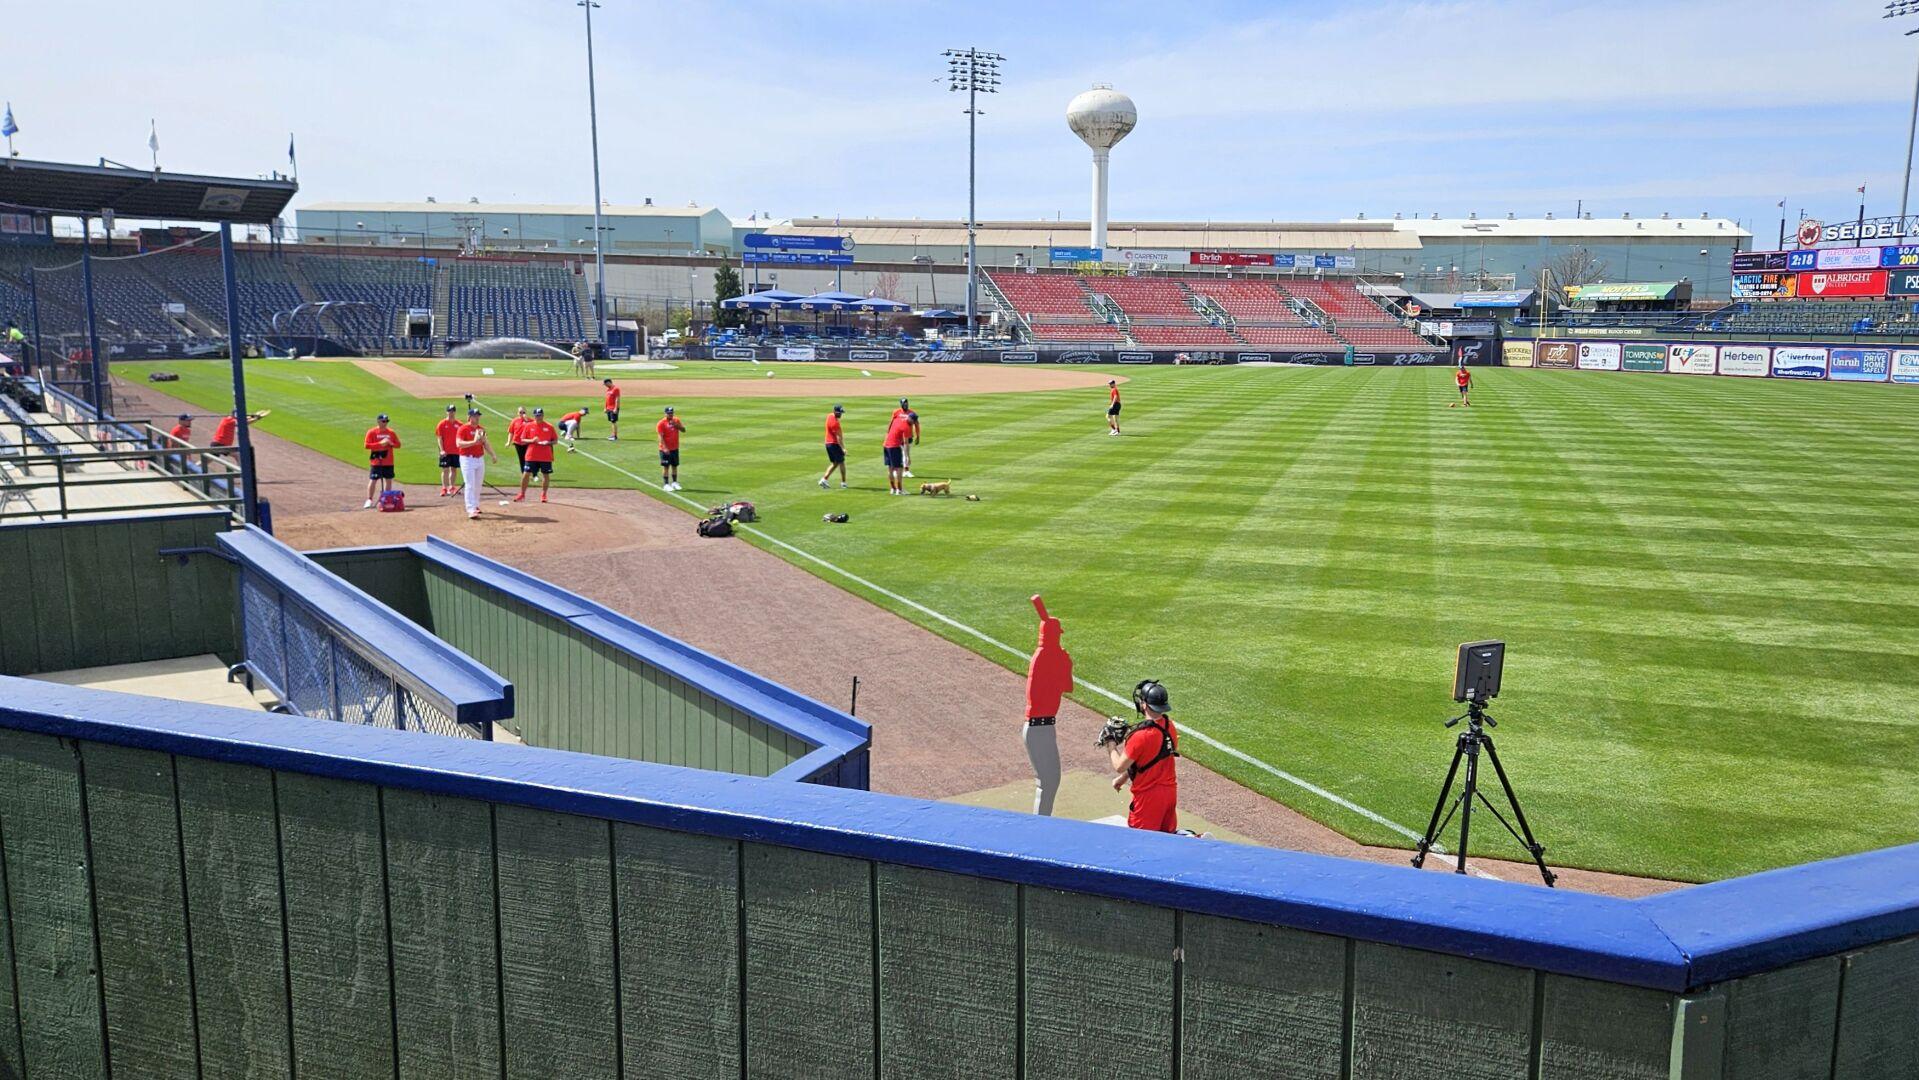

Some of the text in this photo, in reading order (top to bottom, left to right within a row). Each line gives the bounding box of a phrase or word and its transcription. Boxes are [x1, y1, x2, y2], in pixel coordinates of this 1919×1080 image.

[1826, 222, 1906, 240] SEIDEL
[1199, 253, 1222, 261] Ehrlich
[1791, 254, 1814, 266] 2:18
[1899, 255, 1918, 265] 200
[1740, 274, 1778, 284] ARCTIC FIRE
[1826, 273, 1872, 282] ALBRIGHT
[912, 350, 965, 362] R-Phils
[1547, 345, 1569, 359] 1787
[1625, 351, 1657, 360] TOMPKINS
[1724, 351, 1764, 361] Herbein
[1392, 353, 1436, 365] R-Phils
[1786, 353, 1825, 362] iverfront
[1832, 358, 1860, 367] Unruh
